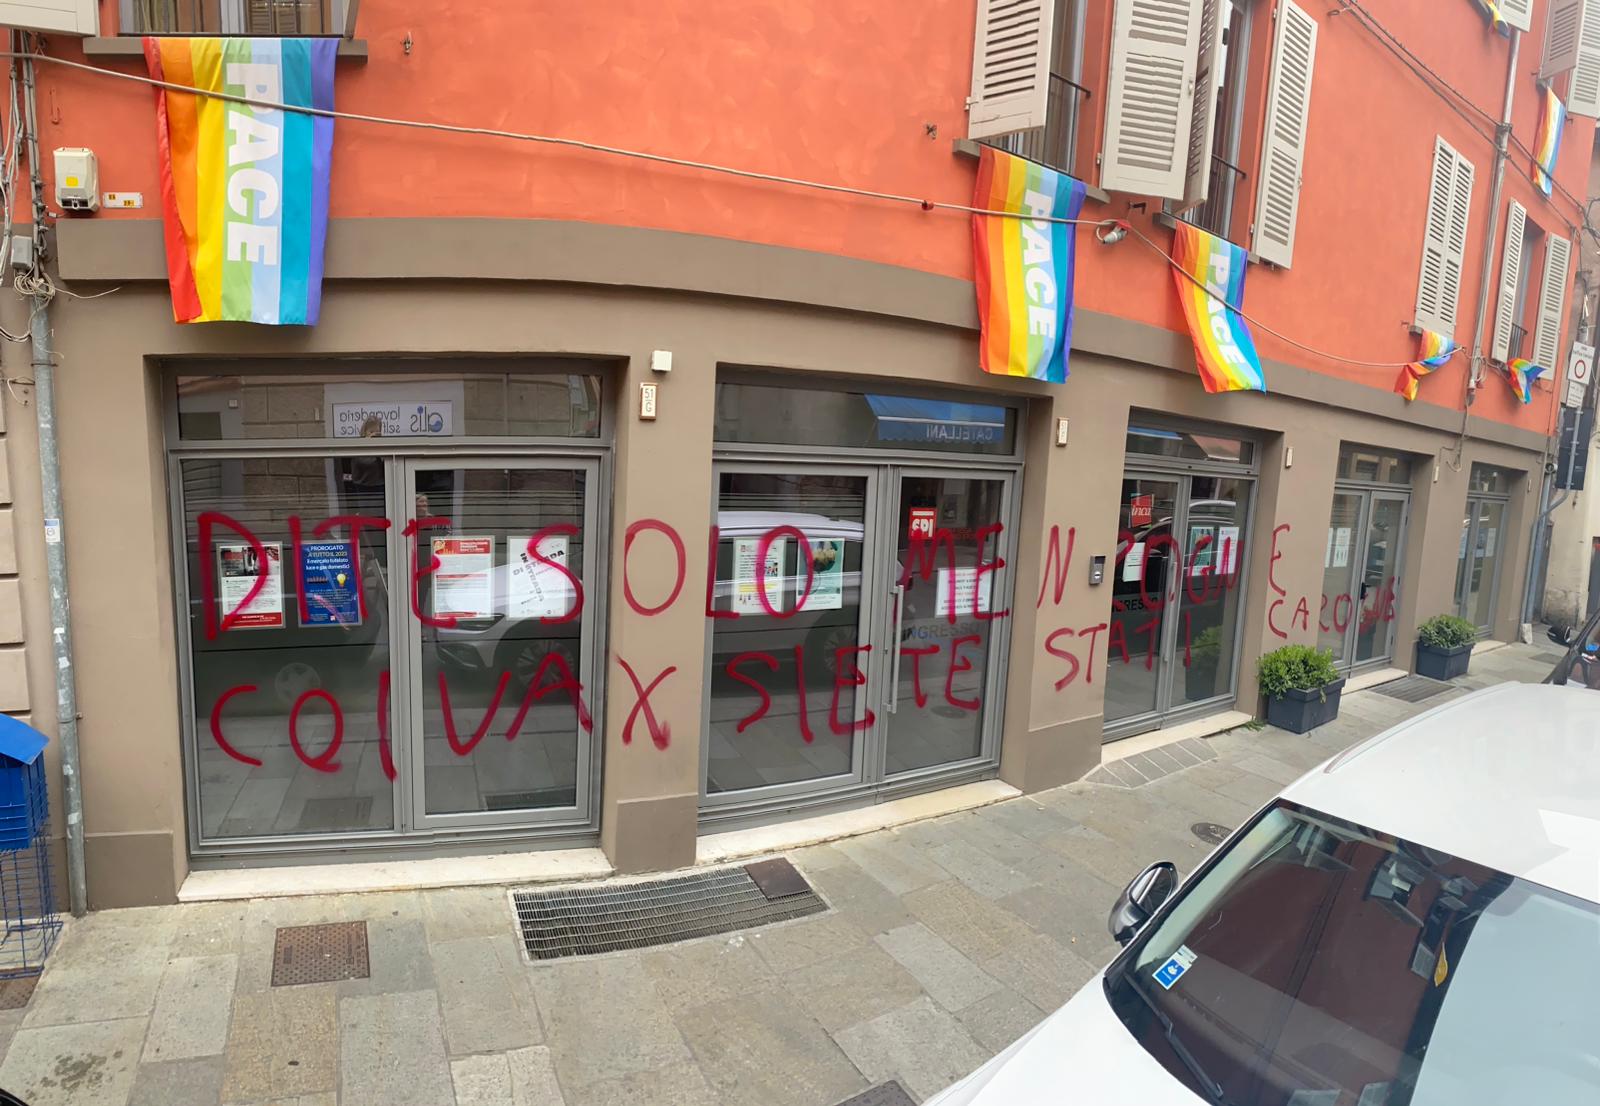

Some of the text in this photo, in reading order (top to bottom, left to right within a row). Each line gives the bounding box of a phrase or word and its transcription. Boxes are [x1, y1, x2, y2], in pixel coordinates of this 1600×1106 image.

[225, 63, 280, 266] PACE
[1020, 189, 1057, 339] PACE
[1206, 252, 1247, 366] PACE
[196, 511, 457, 641] DITE
[528, 518, 814, 624] SOLO
[438, 652, 678, 756] VAX
[725, 635, 982, 743] SIETE
[1045, 611, 1191, 691] STATI
